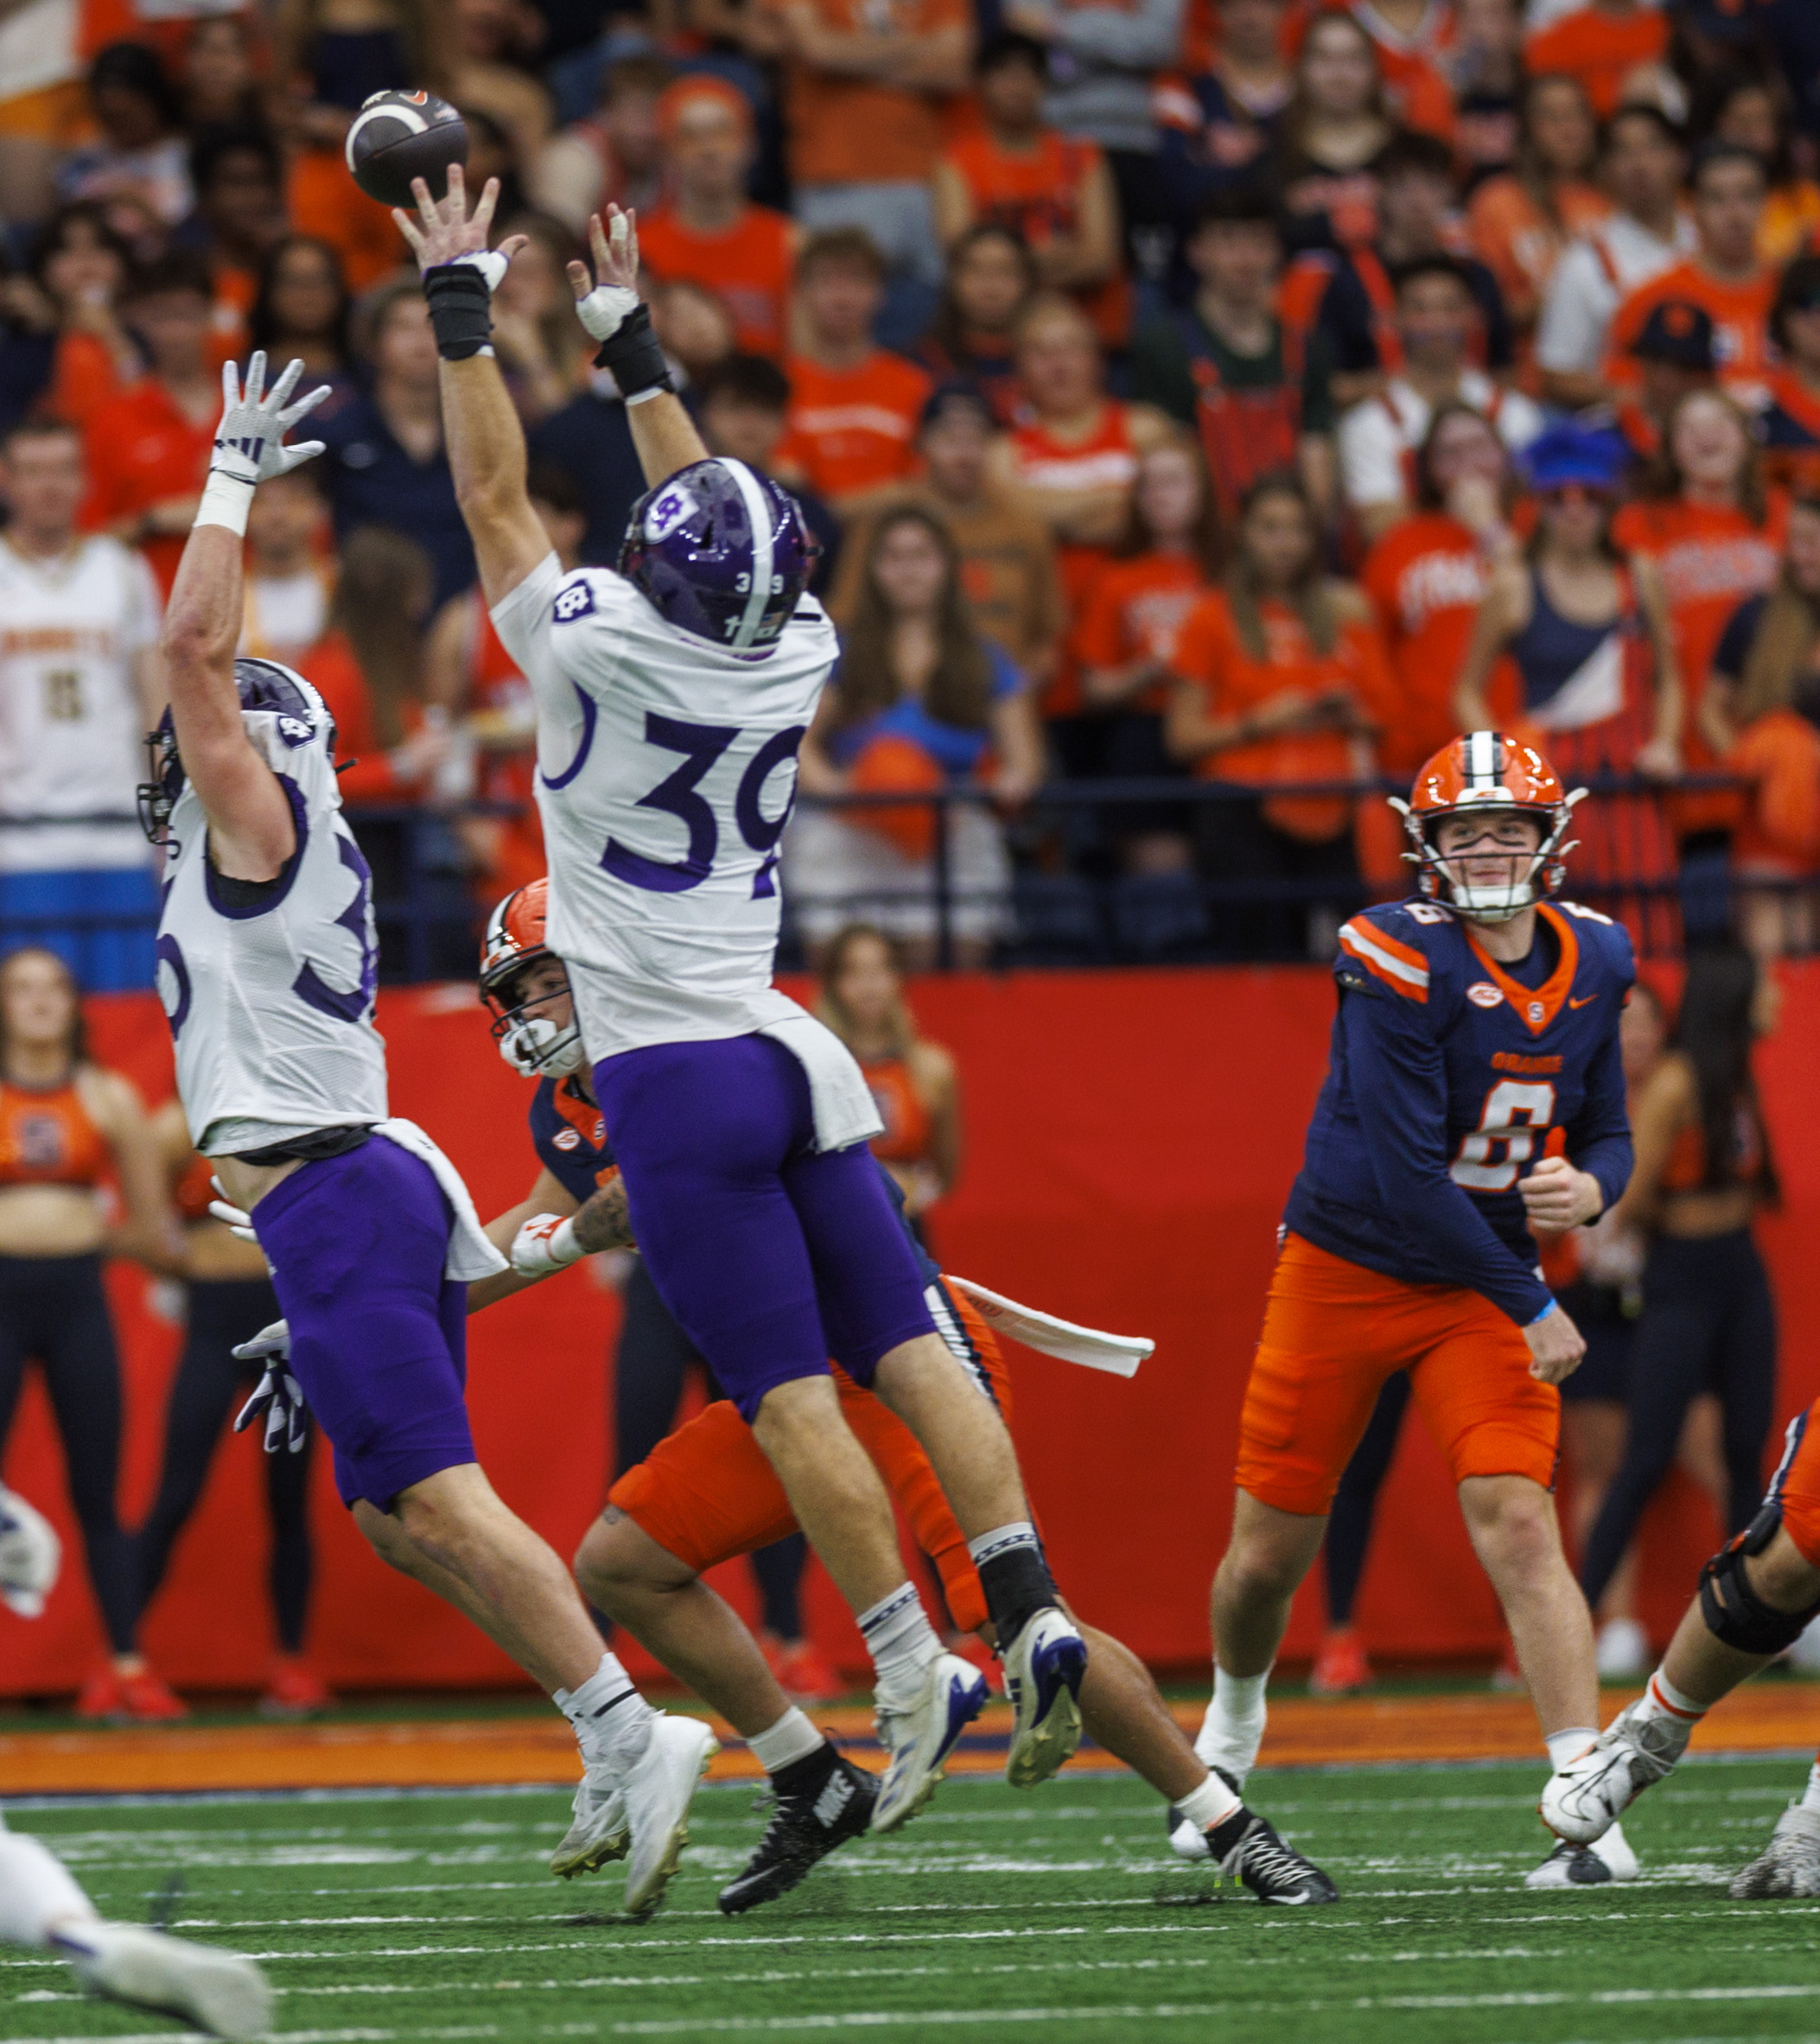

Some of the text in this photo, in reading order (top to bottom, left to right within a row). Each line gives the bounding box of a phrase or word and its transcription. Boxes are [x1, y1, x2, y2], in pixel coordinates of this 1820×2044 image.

[598, 710, 808, 900] 39
[291, 831, 380, 1023] 3
[1448, 1077, 1557, 1193] 6
[812, 1769, 856, 1828] NIKE
